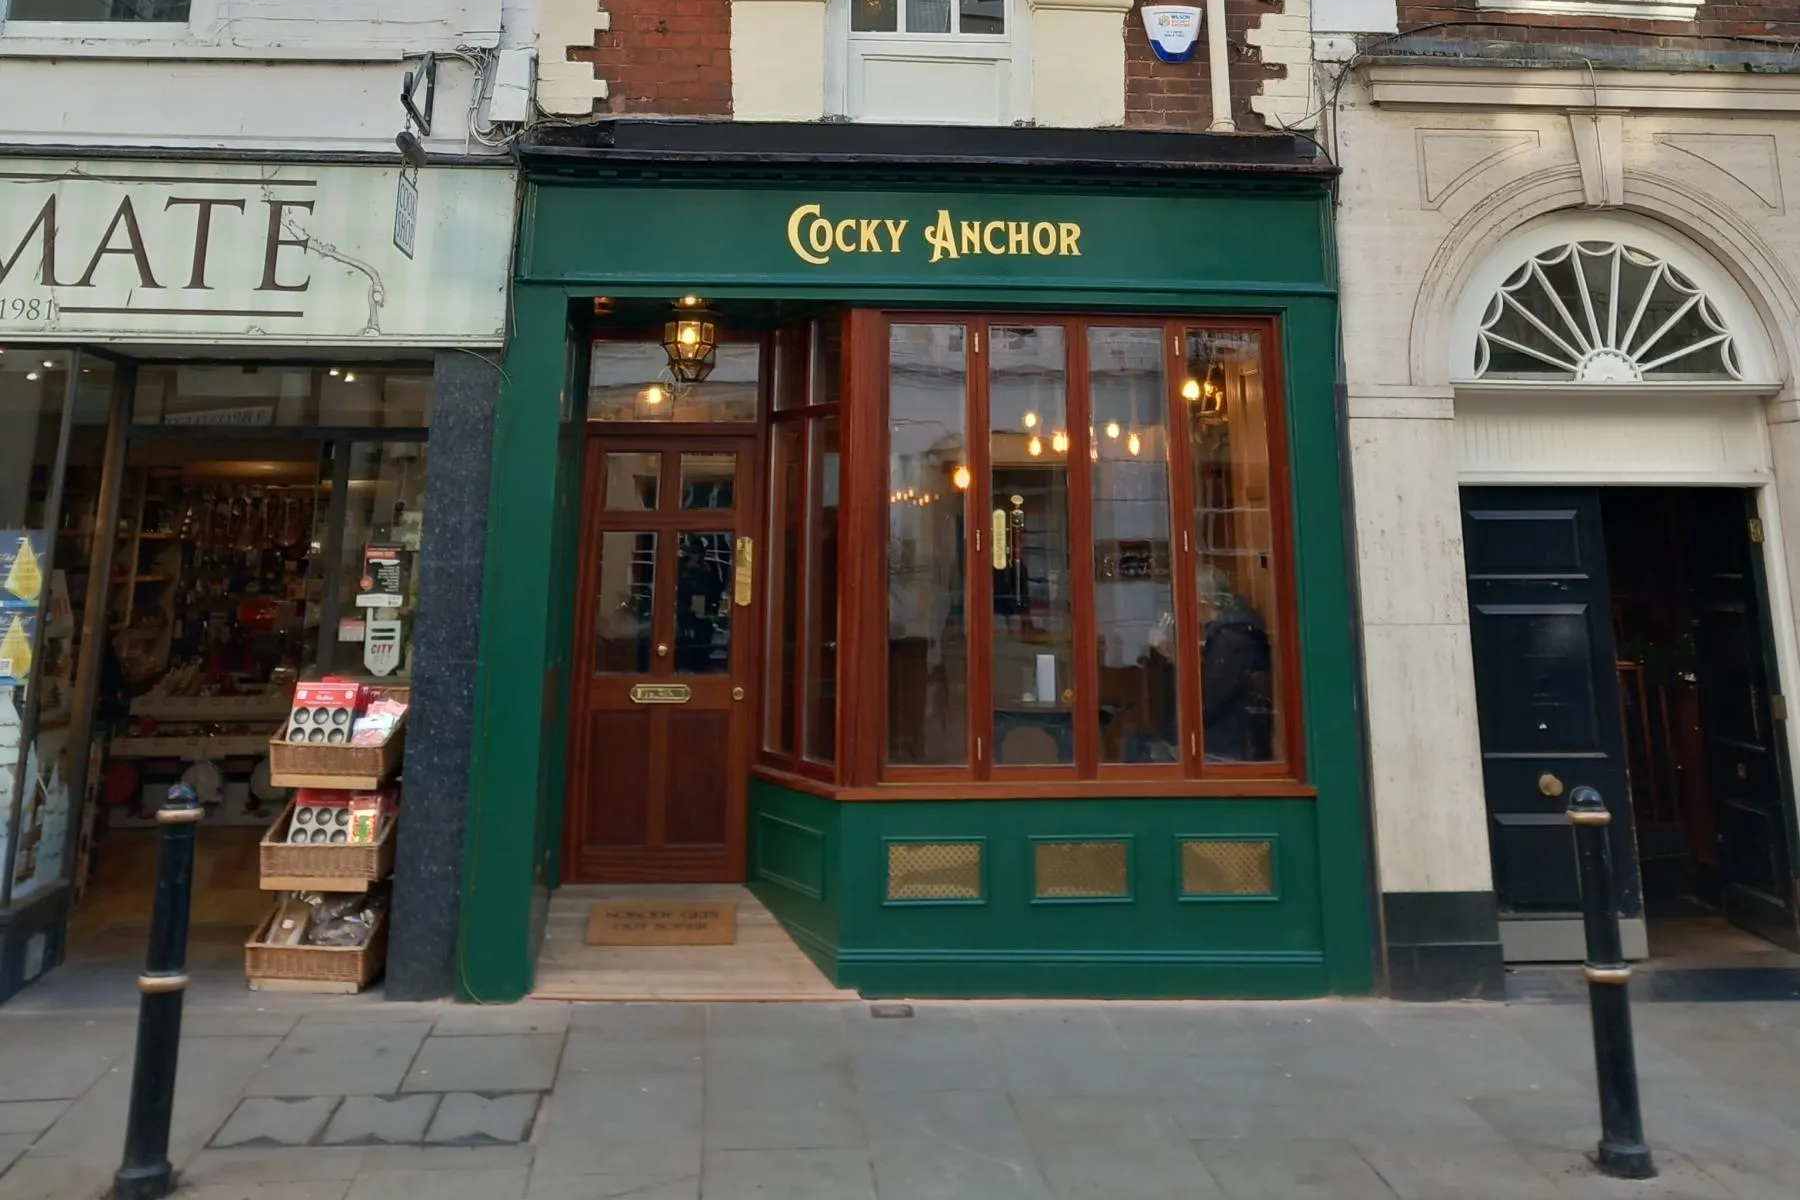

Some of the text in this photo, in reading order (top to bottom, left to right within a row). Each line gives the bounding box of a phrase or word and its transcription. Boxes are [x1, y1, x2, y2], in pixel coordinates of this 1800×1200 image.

[787, 204, 1082, 265] COCKY ANCHOR
[371, 644, 394, 654] CITY
